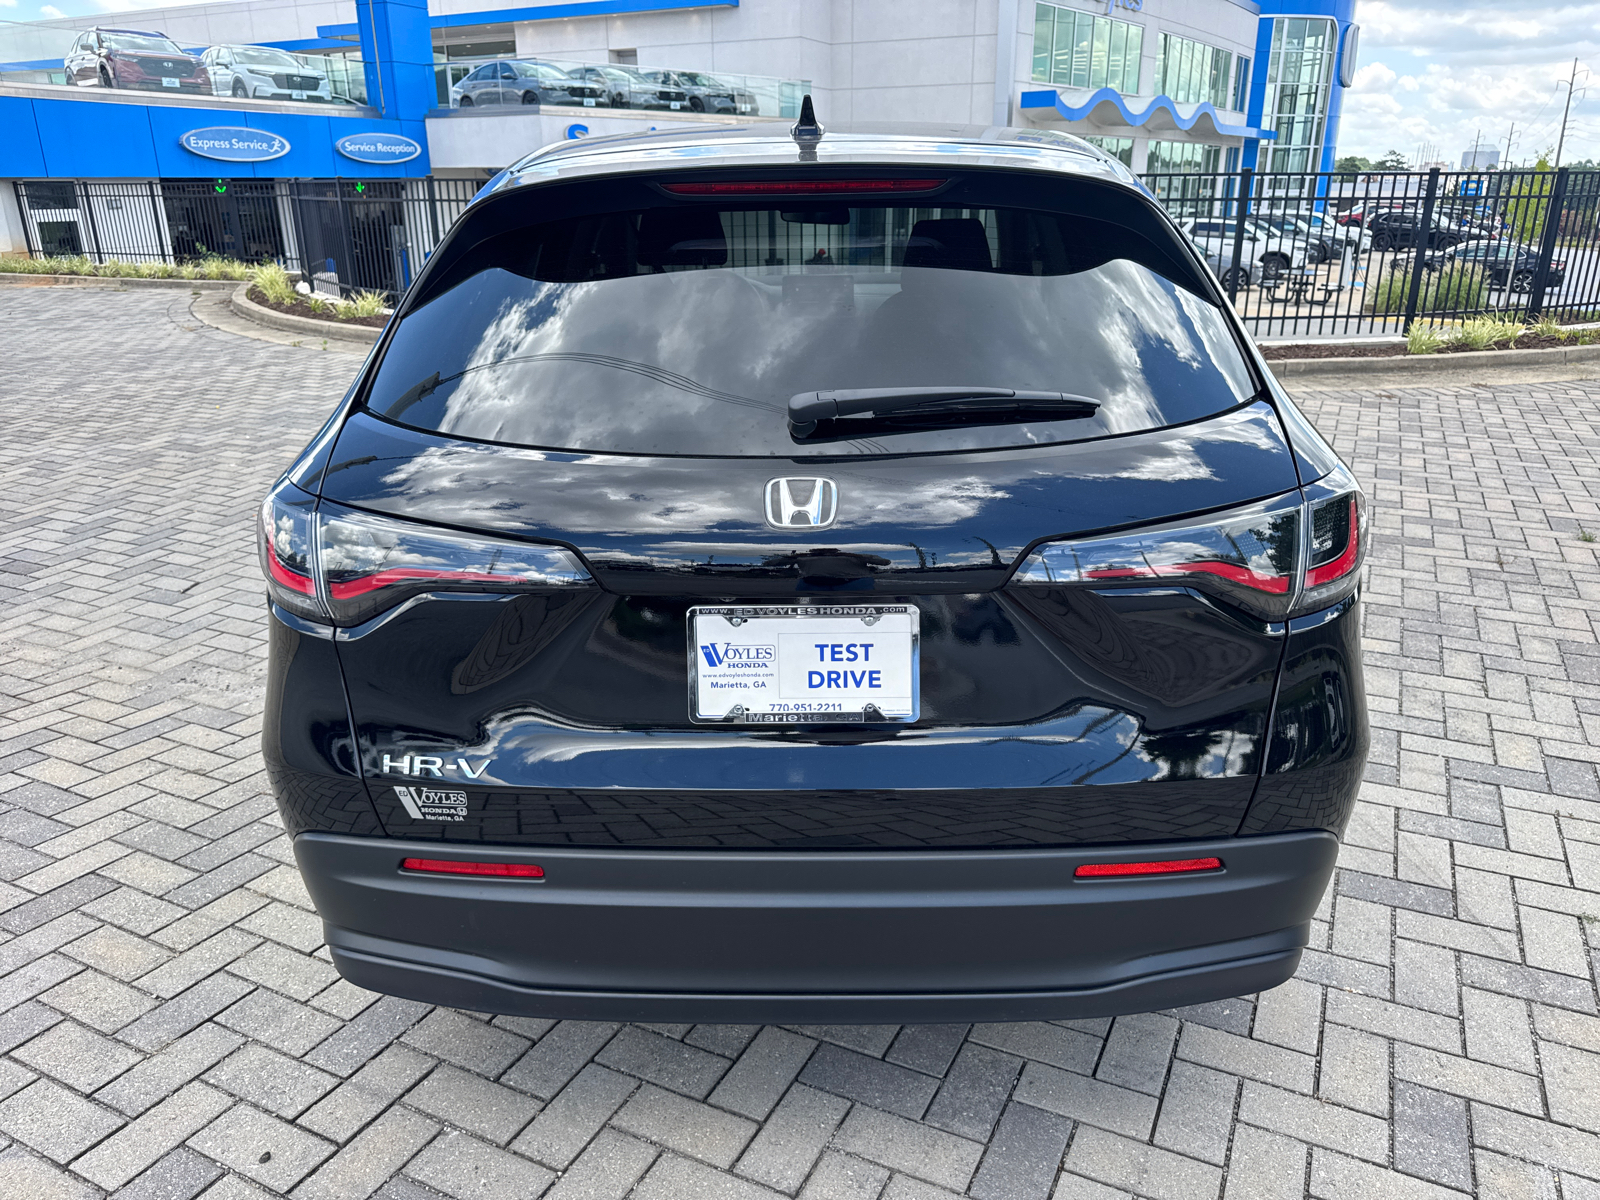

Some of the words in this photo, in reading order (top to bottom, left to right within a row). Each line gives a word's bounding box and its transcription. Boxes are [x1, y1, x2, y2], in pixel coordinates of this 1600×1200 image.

[189, 136, 230, 151] Express
[232, 138, 268, 150] Service
[344, 141, 376, 152] Service
[377, 142, 415, 155] Reception
[814, 643, 874, 662] TEST
[702, 671, 775, 679] www.edvoyleshonda.com
[808, 669, 882, 689] DRIVE
[710, 681, 750, 689] Marietta,
[753, 680, 767, 688] GA
[769, 702, 842, 712] 770-951-2211
[382, 754, 492, 779] HR-V
[408, 786, 466, 807] VOYLES
[425, 814, 454, 822] Marietta,
